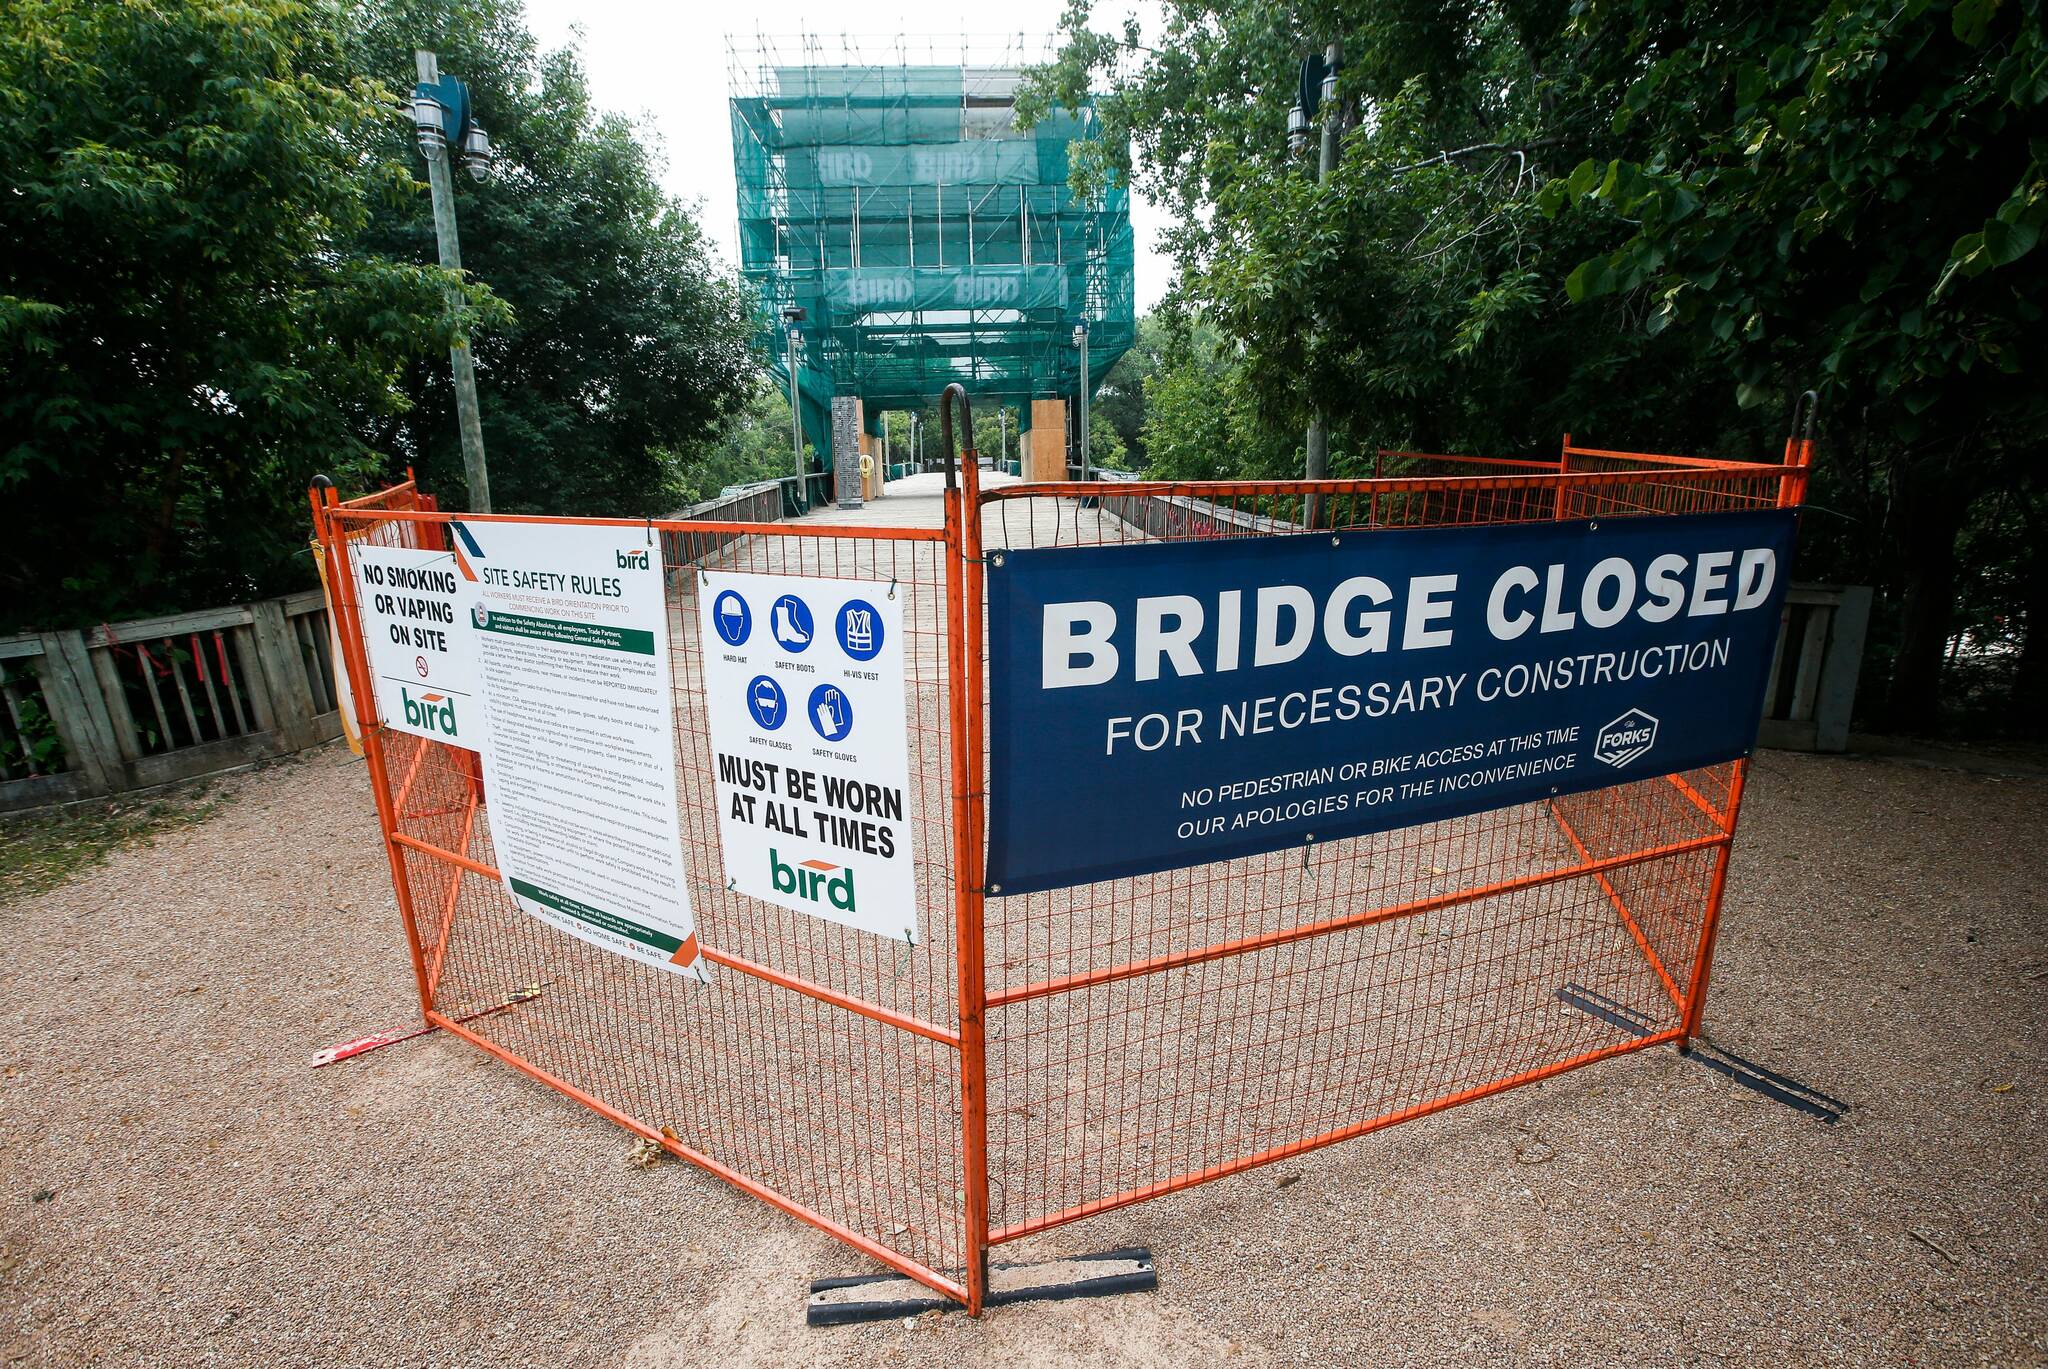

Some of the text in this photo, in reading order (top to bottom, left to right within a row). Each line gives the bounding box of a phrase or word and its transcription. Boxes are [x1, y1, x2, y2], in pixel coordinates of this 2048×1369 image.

[914, 152, 980, 180] BIRD
[847, 275, 1019, 304] BIRD BIRD
[616, 549, 649, 571] bird
[363, 564, 457, 594] NO SMOKING
[483, 567, 622, 598] SITE SAFETY RULES
[375, 593, 454, 624] OR VAPING
[489, 591, 511, 600] WORKERS
[526, 595, 545, 604] RECEIVE
[564, 600, 601, 610] ORIENTATION
[602, 603, 619, 612] PRIOR
[620, 605, 629, 613] TO
[508, 603, 544, 613] COMMENCING
[544, 607, 560, 615] WORK
[571, 610, 582, 618] THIS
[583, 611, 596, 620] SITE
[496, 615, 511, 623] addition
[522, 618, 535, 627] Safety
[535, 620, 556, 630] Absolutes,
[562, 624, 587, 634] employees,
[587, 627, 600, 635] Trade
[600, 629, 621, 638] Partners,
[1042, 548, 1776, 689] BRIDGE CLOSED
[390, 624, 411, 646] ON
[414, 628, 448, 652] SITE
[554, 631, 573, 641] following
[573, 634, 591, 643] General
[591, 636, 606, 645] Safety
[606, 639, 620, 647] Rules.
[723, 654, 747, 664] HARD HAT
[775, 661, 815, 673] SAFETY BOOTS
[843, 669, 879, 681] HI-VIS VEST
[1106, 637, 1731, 756] FOR NECESSARY CONSTRUCTION
[401, 687, 458, 736] bird
[749, 736, 793, 751] SAFETY GLASSES
[1602, 728, 1651, 749] FORKS
[812, 748, 857, 763] SAFETY GLOVES
[1181, 726, 1580, 808] NO PEDESTRIAN OR BIKE ACCESS AT THIS TIME
[718, 753, 903, 821] MUST BE WORN
[1177, 754, 1576, 838] OUR APOLOGIES FOR THE INCONVENIENCE
[731, 792, 895, 859] AT ALL TIMES
[769, 848, 856, 913] bird
[537, 888, 548, 897] Work
[548, 892, 559, 902] safely
[600, 912, 616, 923] hazards
[623, 921, 653, 938] appropriately
[545, 909, 561, 921] WORK
[582, 924, 592, 934] GO
[592, 928, 610, 941] HOME
[636, 944, 664, 961] BE SAFE.
